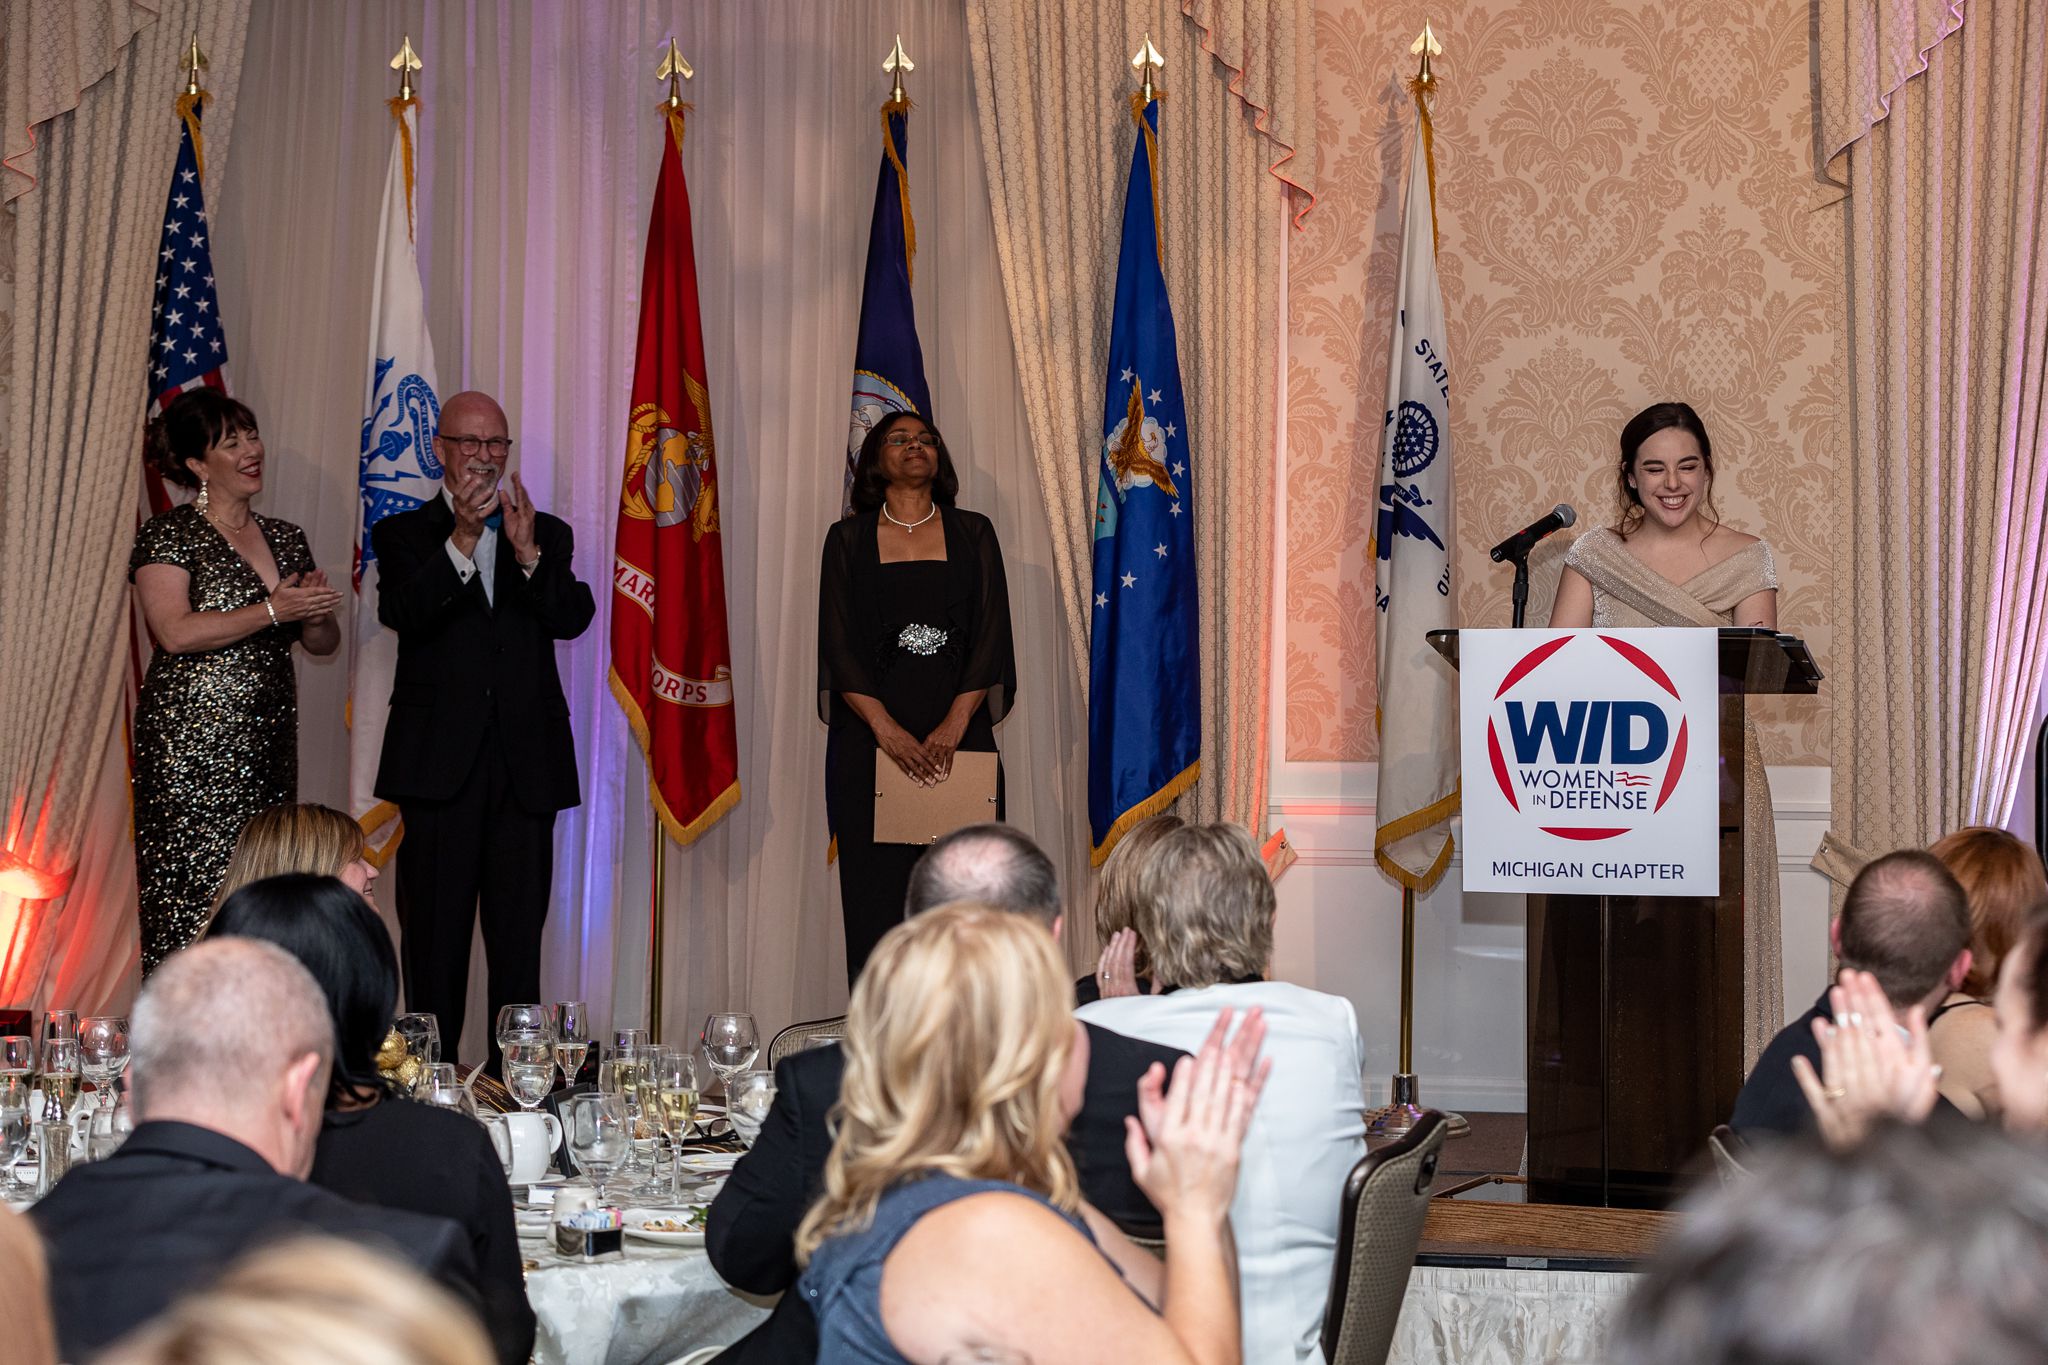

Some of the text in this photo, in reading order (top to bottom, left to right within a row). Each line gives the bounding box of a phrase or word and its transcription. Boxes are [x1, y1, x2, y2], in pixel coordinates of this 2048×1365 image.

[1415, 338, 1449, 408] STATE
[614, 560, 655, 608] MAR
[652, 661, 707, 703] ORPS
[1505, 701, 1668, 764] WID
[1520, 770, 1613, 788] WOMEN
[1533, 791, 1646, 809] IN DEFENSE
[1493, 862, 1684, 879] MICHIGAN CHAPTER
